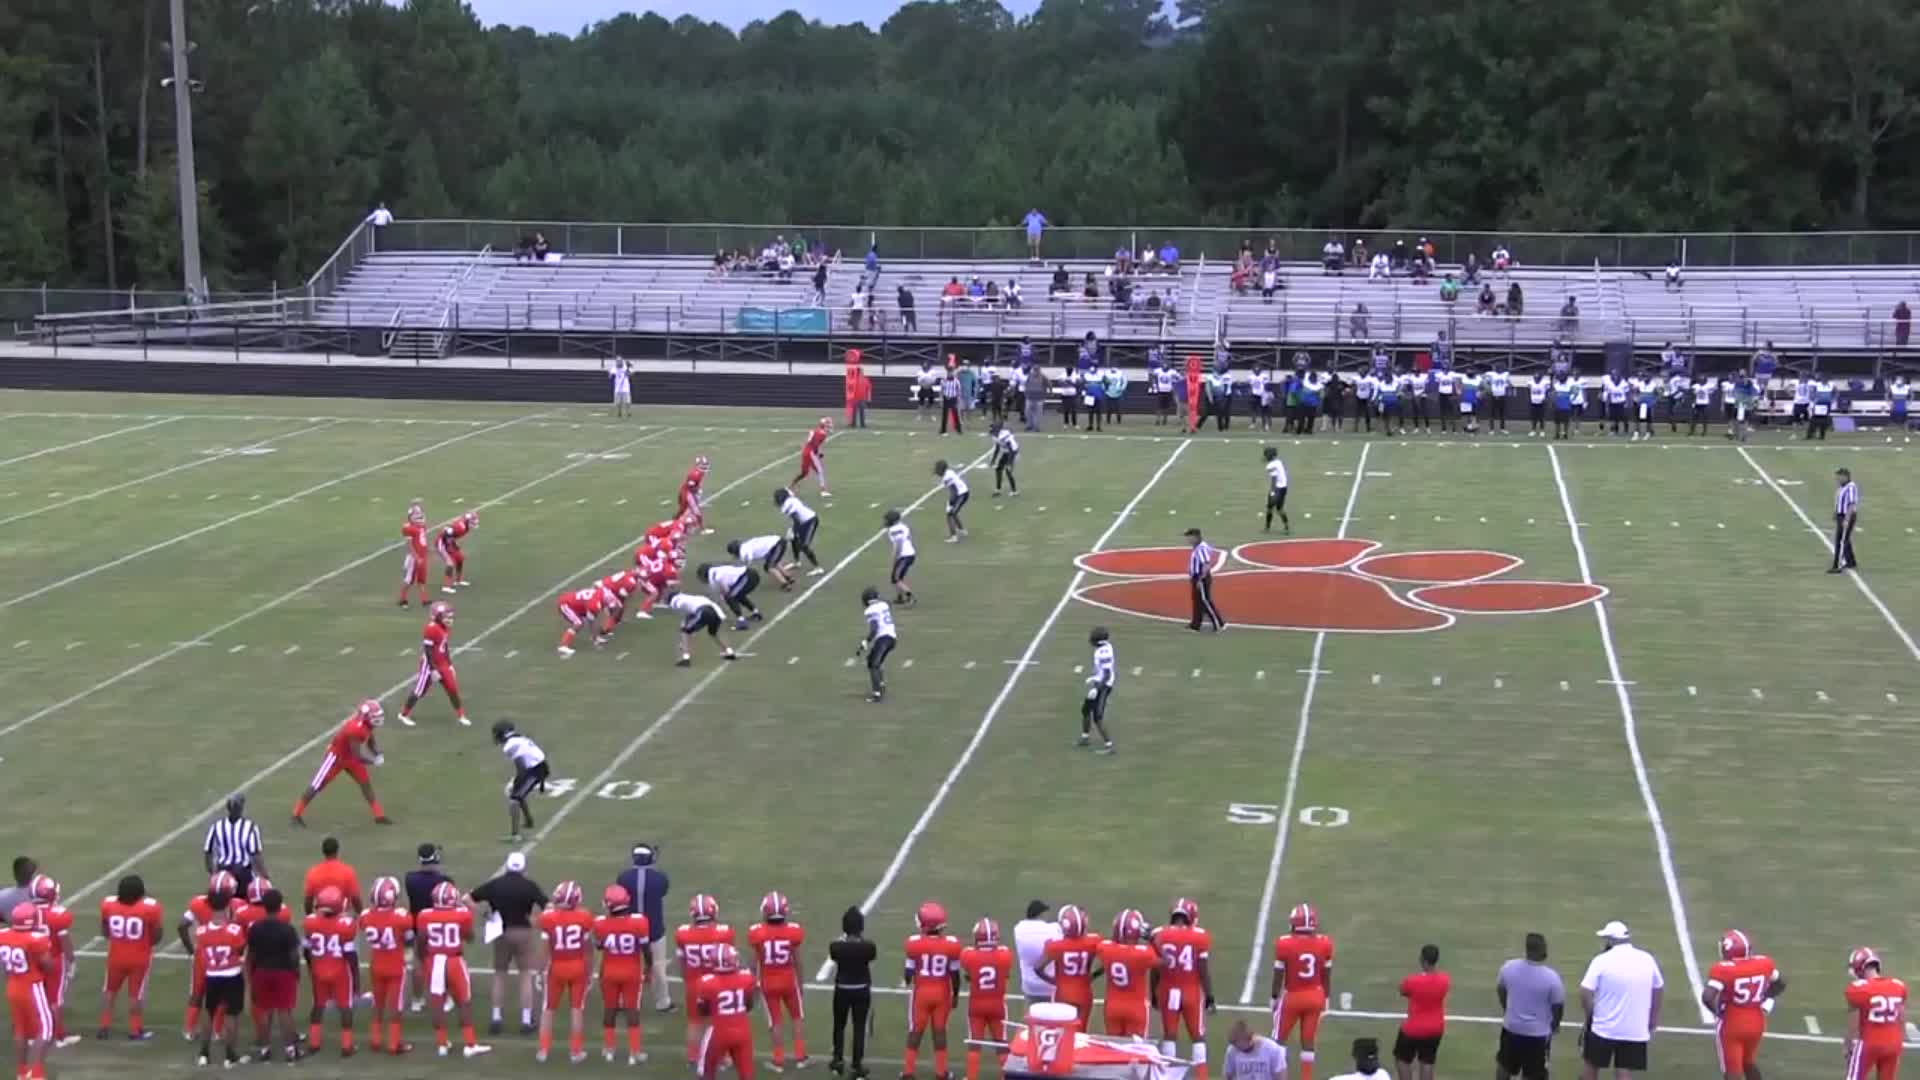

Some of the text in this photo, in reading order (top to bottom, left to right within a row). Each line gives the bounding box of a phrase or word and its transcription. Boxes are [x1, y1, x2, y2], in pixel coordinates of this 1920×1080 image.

[1226, 803, 1349, 826] 50
[310, 933, 342, 957] 34
[365, 927, 397, 949] 24
[427, 923, 461, 947] 50
[554, 924, 582, 949] 12
[604, 933, 635, 954] 48
[206, 945, 231, 966] 17
[763, 940, 790, 964] 15
[1063, 951, 1089, 975] 51
[920, 954, 947, 977] 18
[978, 966, 996, 989] 2
[1110, 962, 1129, 987] 9
[1298, 953, 1316, 978] 3
[717, 988, 747, 1014] 21
[1733, 975, 1765, 1004] 57
[1868, 995, 1903, 1023] 25
[1040, 1029, 1056, 1047] G
